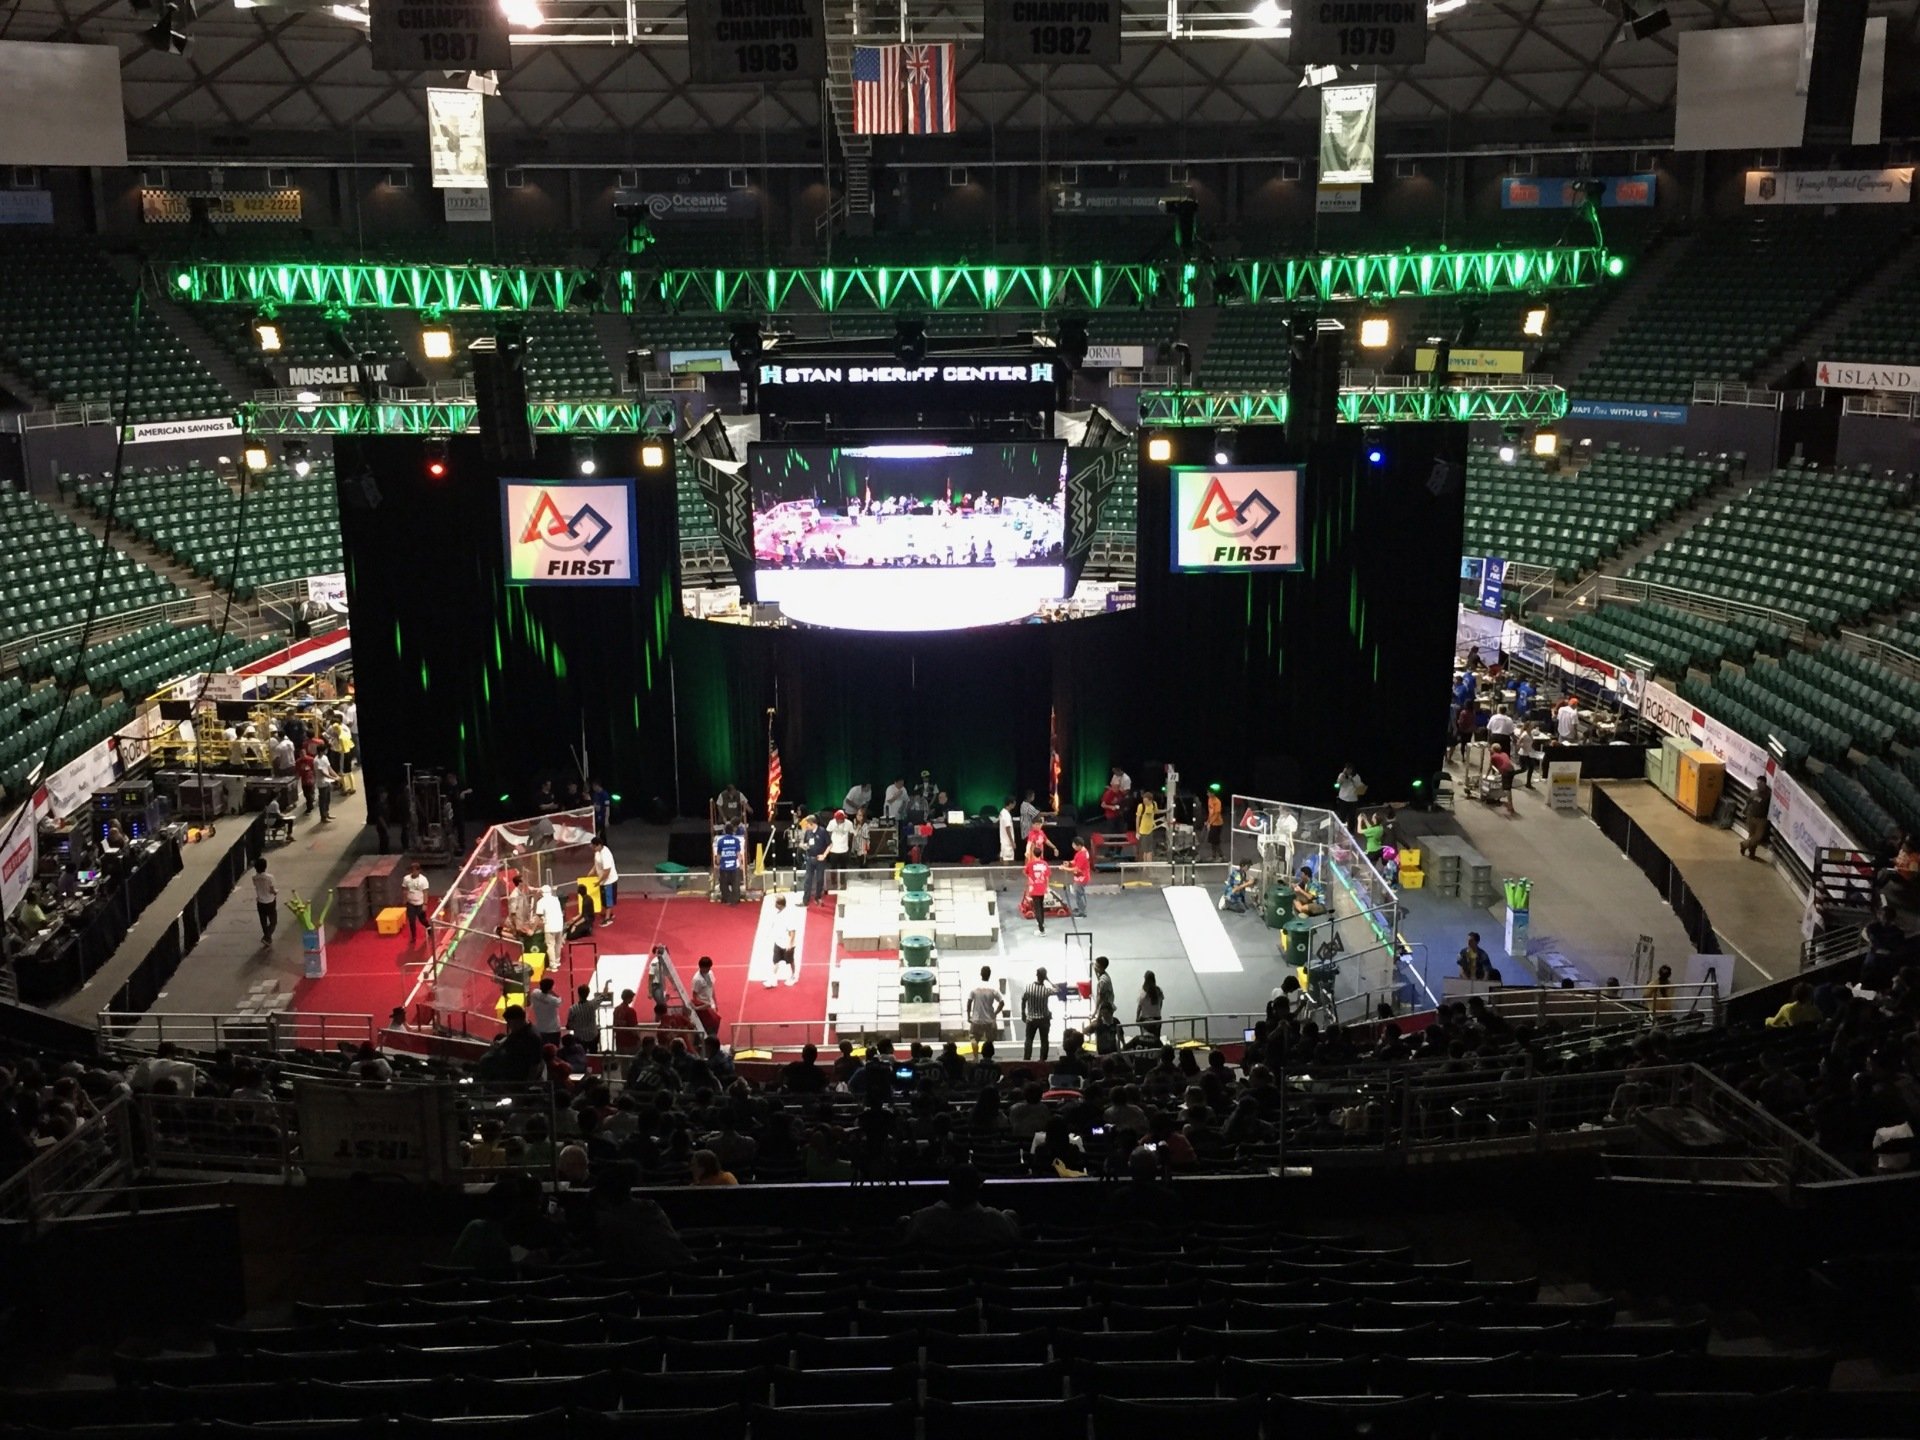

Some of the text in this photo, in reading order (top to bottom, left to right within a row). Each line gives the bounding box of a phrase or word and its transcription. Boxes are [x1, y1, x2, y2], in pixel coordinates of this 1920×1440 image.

[1013, 2, 1109, 23] CHAMPION
[1320, 3, 1415, 23] CHAMPION
[716, 18, 813, 41] CHAMPION
[419, 33, 479, 61] 1987
[1030, 26, 1092, 55] 1982
[1338, 27, 1396, 55] 1979
[735, 43, 798, 73] 1983
[244, 199, 297, 212] 422-2222
[672, 194, 728, 207] Oceanic
[289, 366, 348, 385] MUSCLE
[784, 366, 842, 383] STAN
[943, 365, 1027, 382] CENTER
[1837, 369, 1911, 387] ISLAND
[1609, 407, 1633, 417] WITH
[1635, 408, 1648, 418] US
[138, 425, 185, 438] AMERICAN
[187, 423, 225, 433] SAVINGS
[1213, 545, 1282, 562] FIRST
[548, 559, 615, 576] FIRST
[1645, 697, 1690, 738] ROBOTICS
